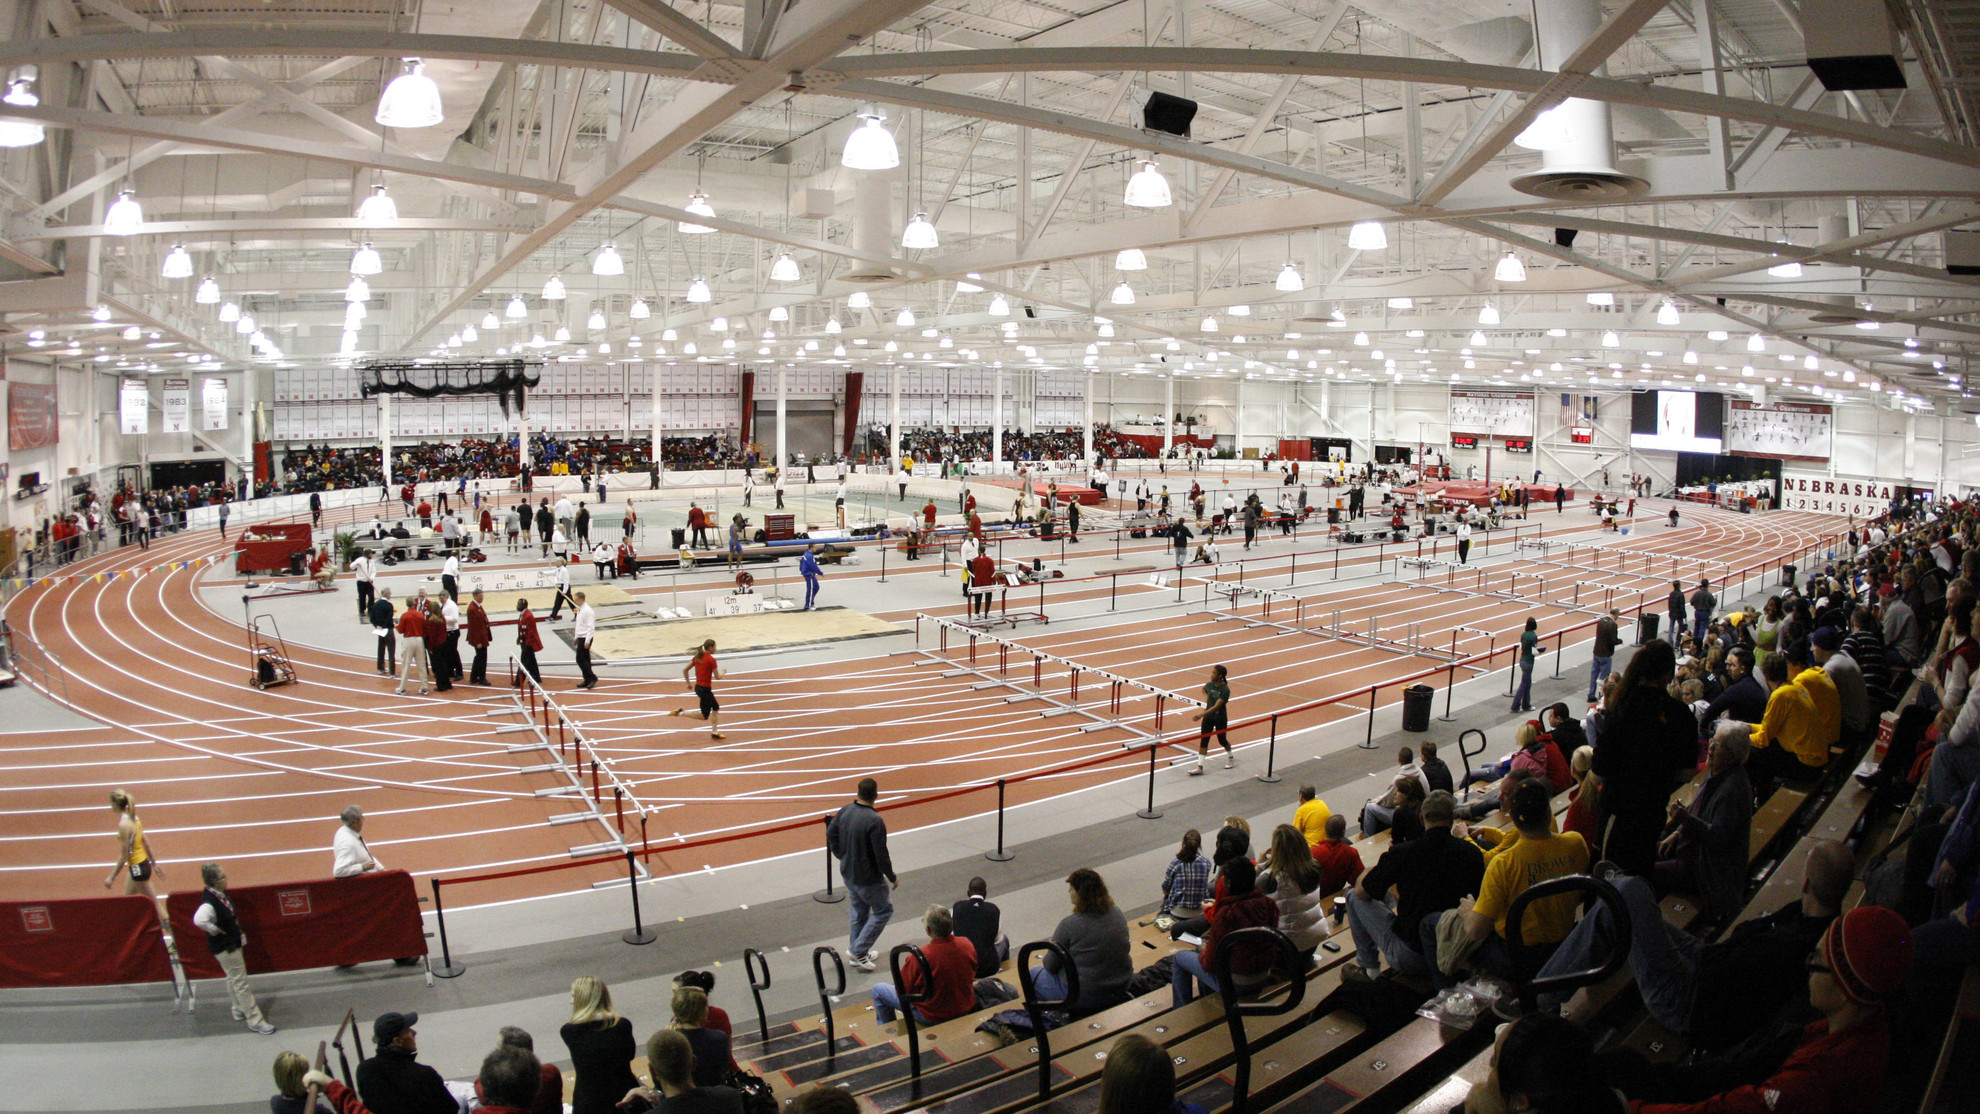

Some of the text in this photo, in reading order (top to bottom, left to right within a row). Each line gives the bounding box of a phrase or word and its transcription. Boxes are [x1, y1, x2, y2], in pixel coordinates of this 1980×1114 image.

[166, 398, 187, 406] 1983
[173, 423, 180, 431] N
[1783, 478, 1890, 499] NEBRASKA
[1786, 498, 1888, 515] 1 2 3 4 5 6 7 8
[724, 596, 737, 605] 12m
[1372, 1060, 1386, 1071] 37
